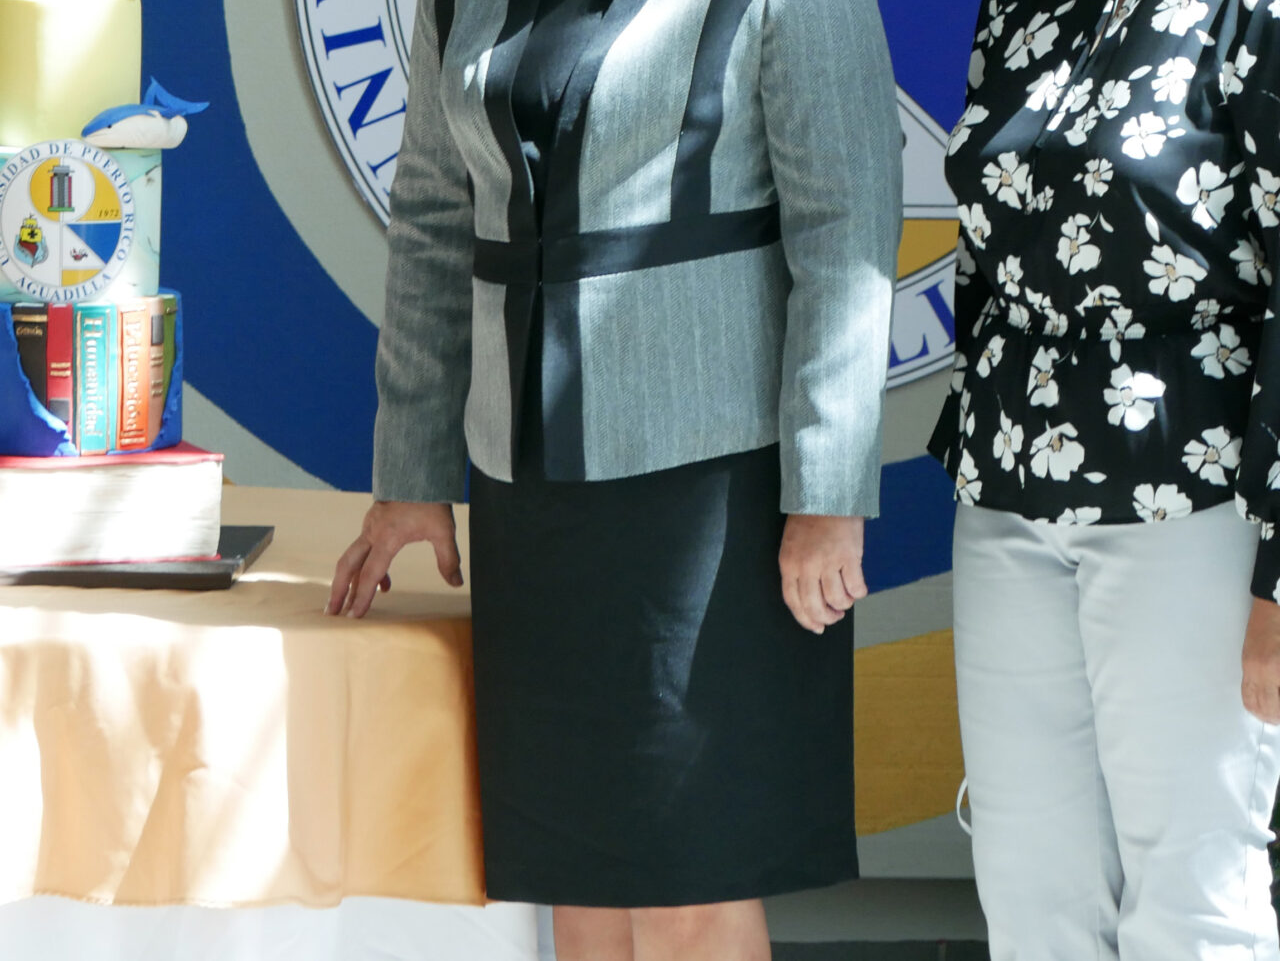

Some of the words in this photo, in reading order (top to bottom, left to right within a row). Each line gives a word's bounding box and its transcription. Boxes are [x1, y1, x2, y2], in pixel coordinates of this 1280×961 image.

[49, 142, 73, 155] DE
[81, 145, 134, 204] PUERTO
[117, 213, 135, 262] RICO
[98, 209, 120, 218] 1972
[16, 273, 111, 303] AGUADILLA
